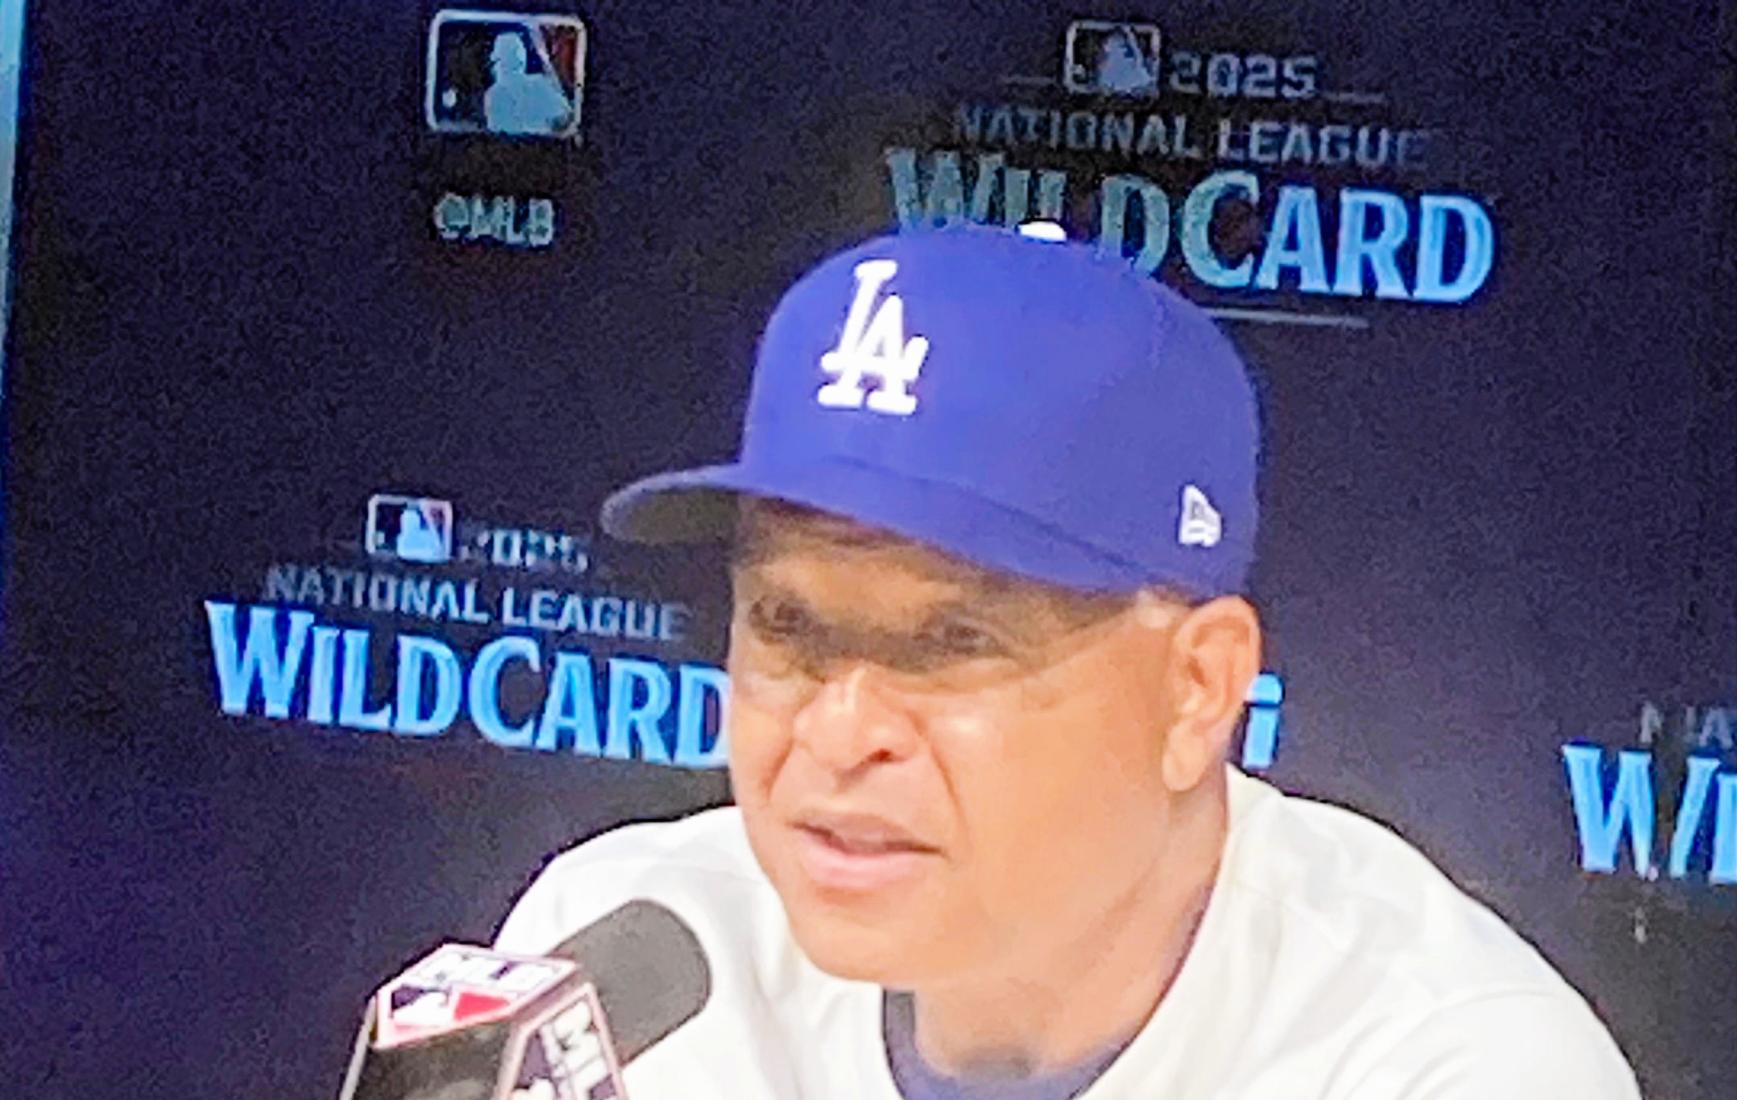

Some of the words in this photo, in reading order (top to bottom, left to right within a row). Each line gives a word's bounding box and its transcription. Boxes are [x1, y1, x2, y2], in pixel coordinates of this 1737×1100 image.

[1170, 52, 1319, 100] 2025
[956, 102, 1197, 159] NATIONAL
[1217, 116, 1431, 173] LEAGUE
[817, 259, 930, 416] LA
[265, 562, 491, 625] NATIONAL
[502, 586, 690, 642] LEAGUE
[204, 599, 736, 769] WILDCARD
